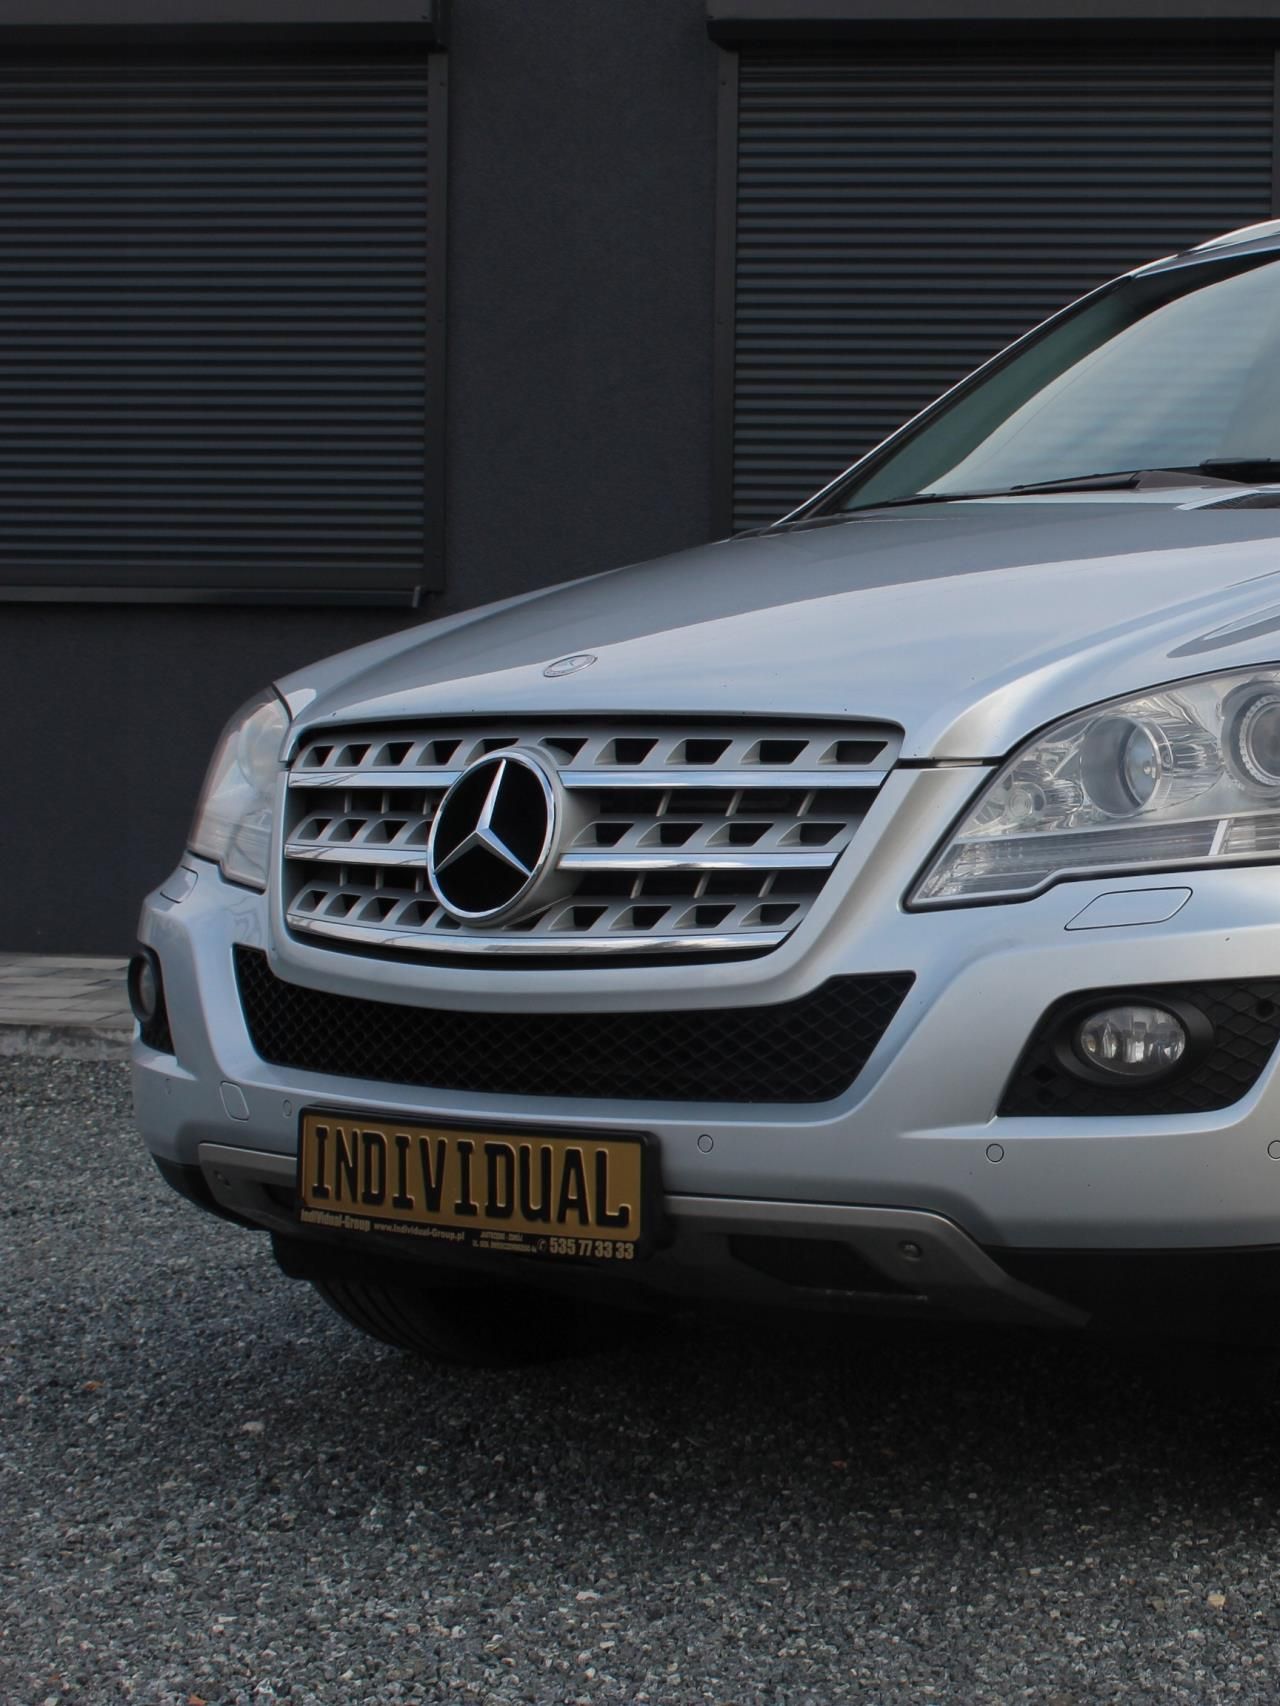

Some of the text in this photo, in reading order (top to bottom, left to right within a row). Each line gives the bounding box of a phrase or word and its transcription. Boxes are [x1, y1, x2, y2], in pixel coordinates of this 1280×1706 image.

[312, 1125, 631, 1228] INDIVIDUAL
[550, 1237, 576, 1256] 535
[578, 1239, 593, 1257] 77
[595, 1240, 613, 1259] 33
[615, 1242, 634, 1260] 33
